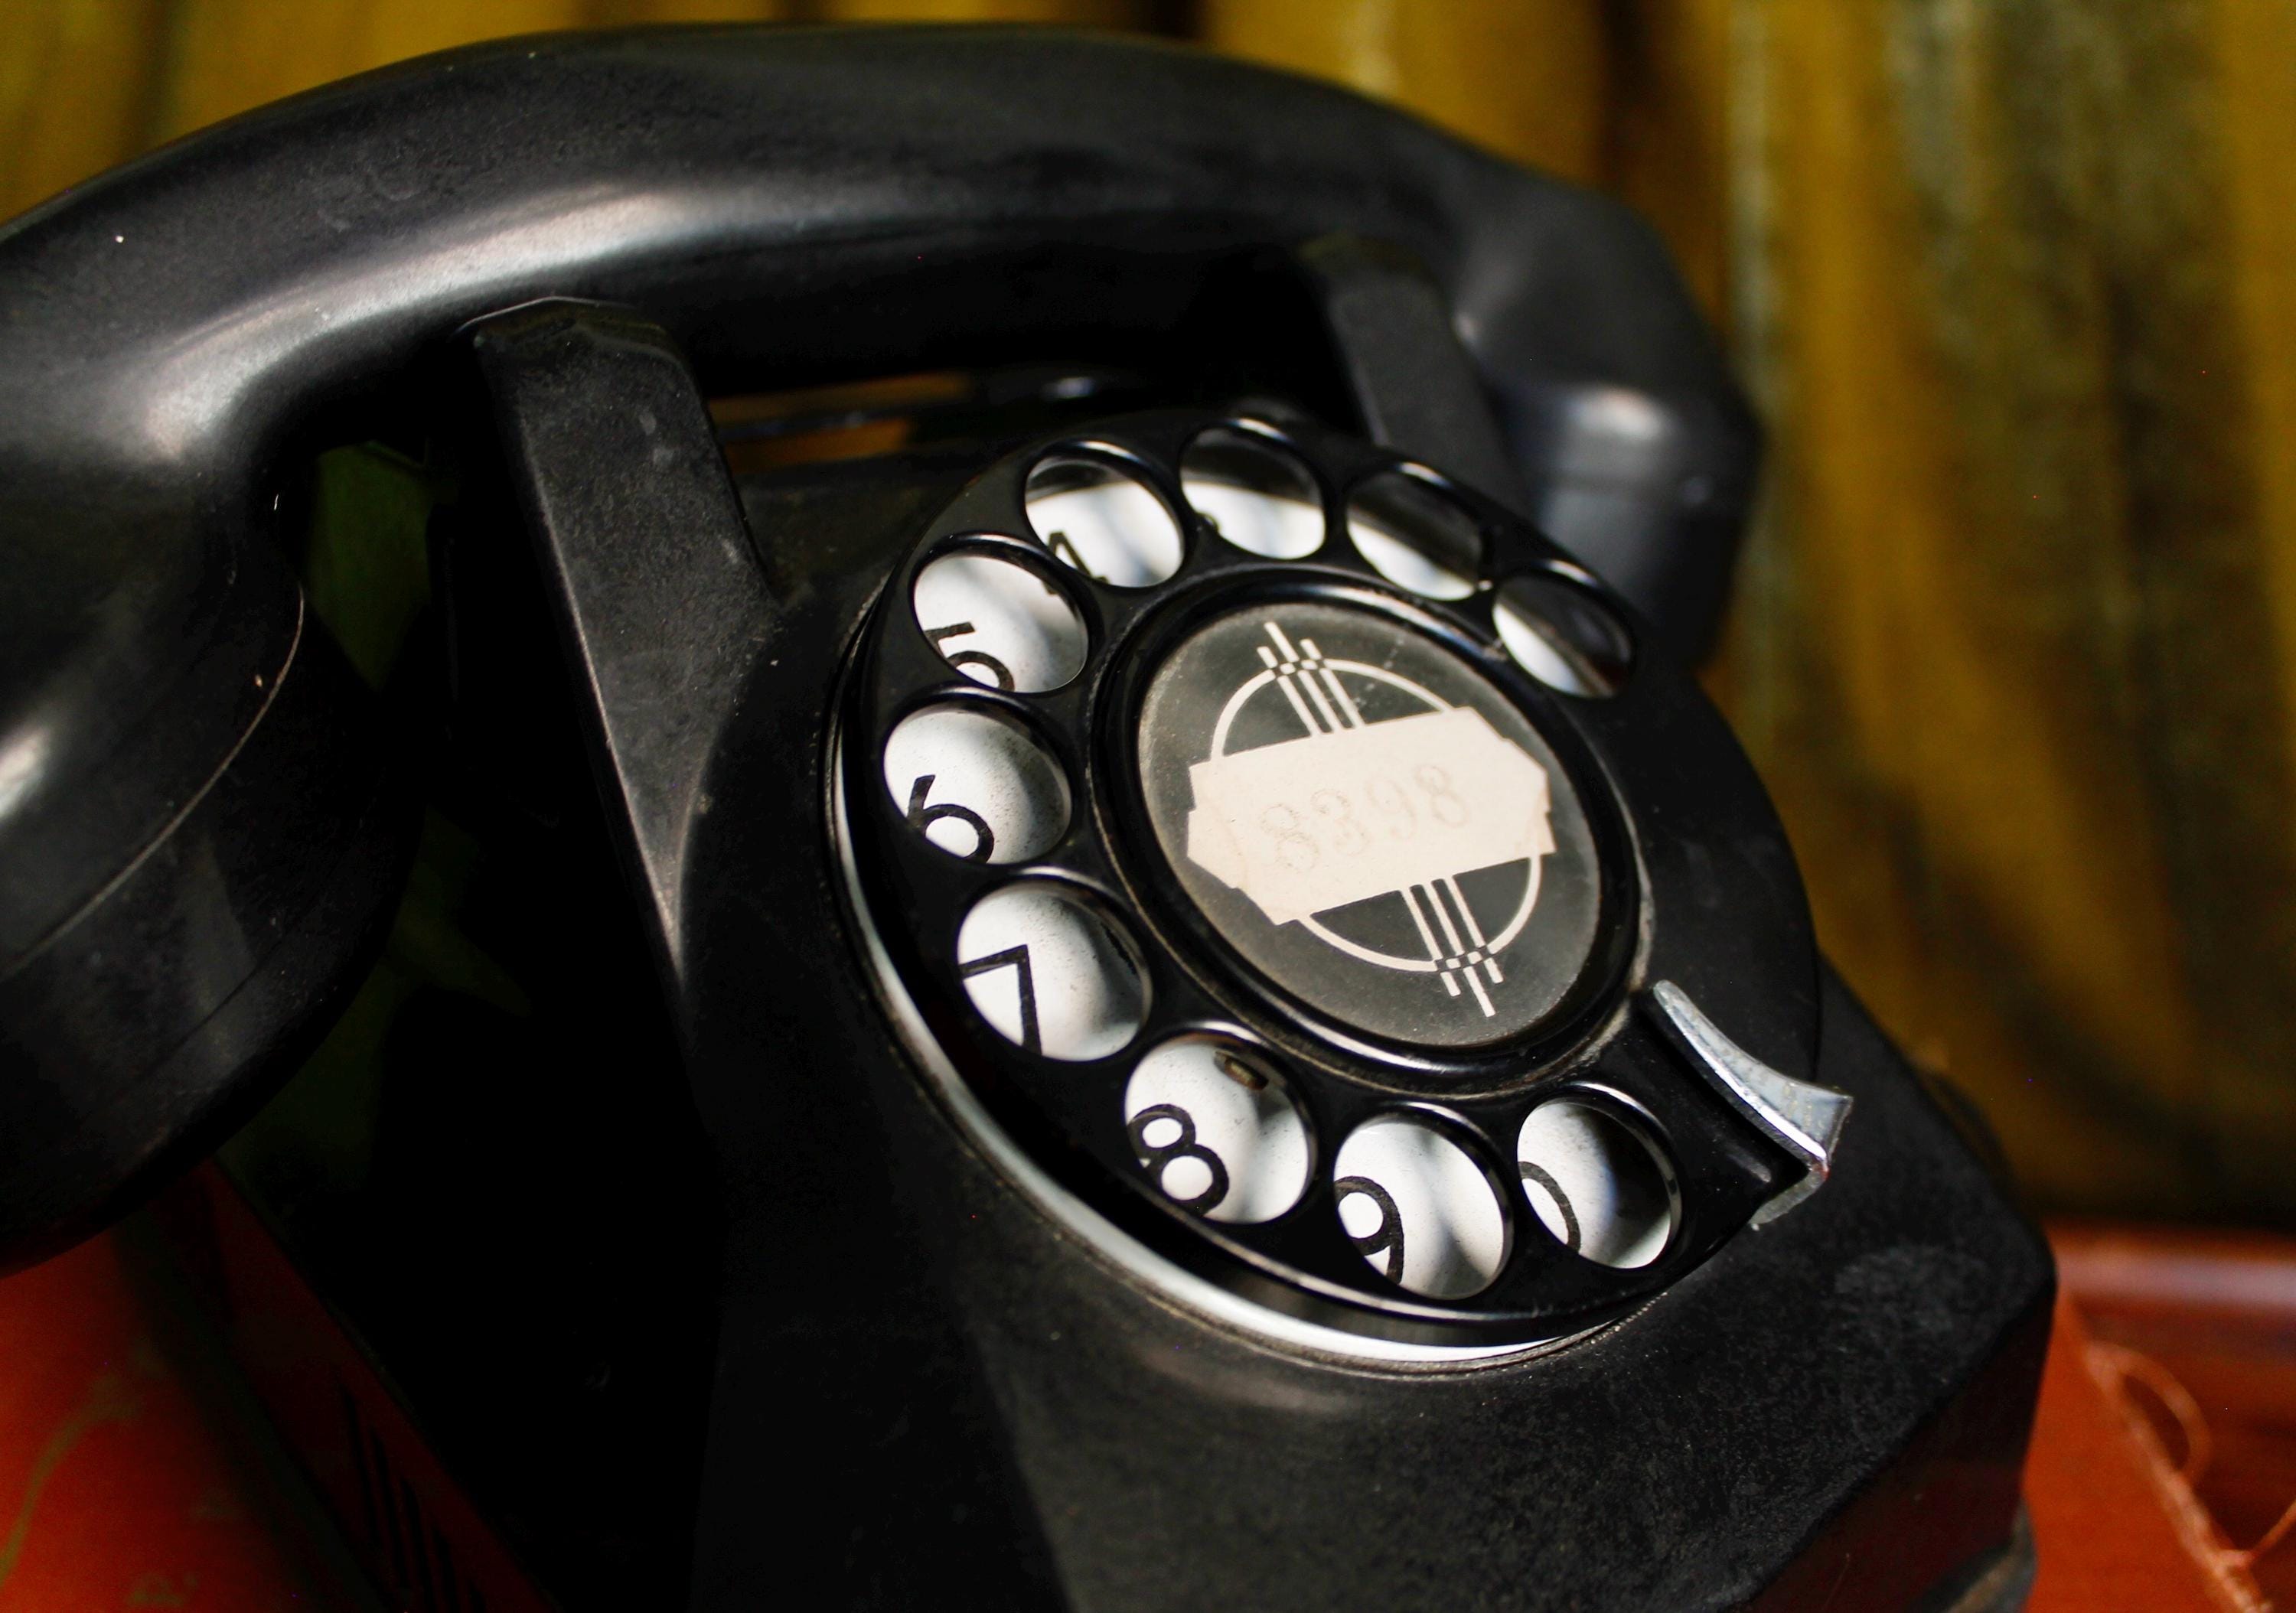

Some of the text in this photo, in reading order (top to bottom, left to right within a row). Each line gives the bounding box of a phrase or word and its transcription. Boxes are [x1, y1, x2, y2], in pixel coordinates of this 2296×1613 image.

[924, 621, 1015, 690] 5
[906, 774, 995, 865] 6
[1259, 763, 1473, 875] 8398
[958, 943, 1042, 1056] 7
[1127, 1103, 1229, 1217] 8
[1335, 1175, 1404, 1286] 9
